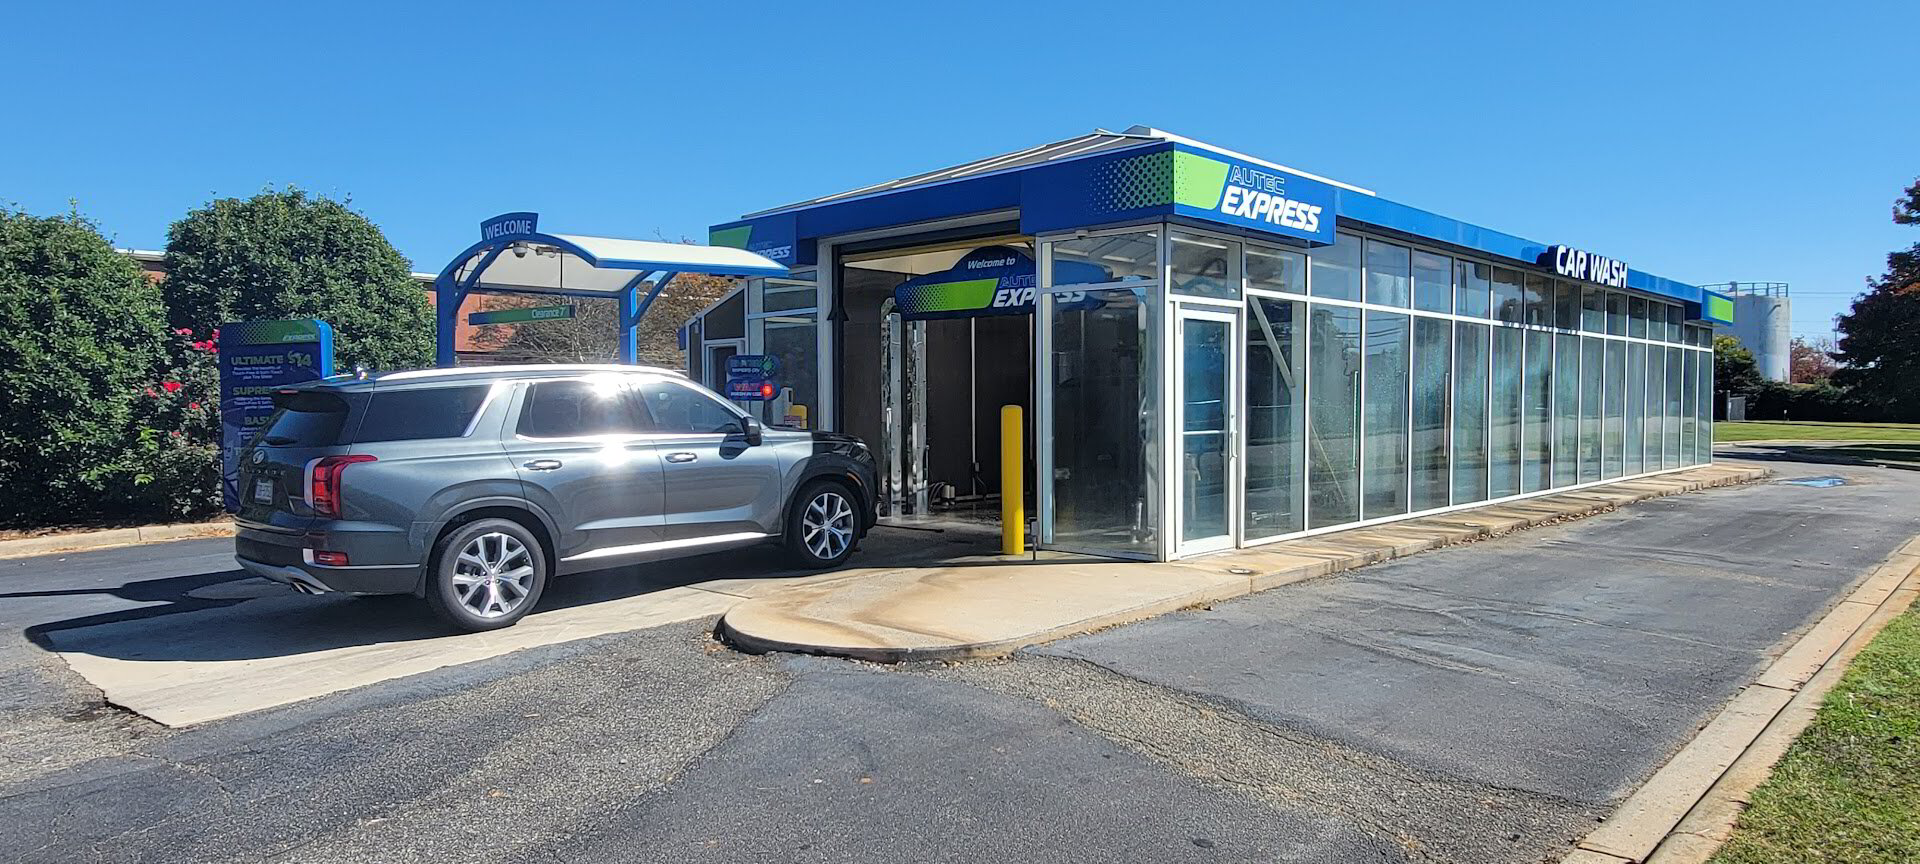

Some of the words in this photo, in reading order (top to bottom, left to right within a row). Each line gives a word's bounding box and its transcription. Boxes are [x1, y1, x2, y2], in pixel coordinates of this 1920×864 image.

[1229, 165, 1285, 195] AUTEC
[485, 220, 532, 240] WELCOME
[967, 258, 1005, 269] Welcome
[1005, 257, 1016, 266] to
[1556, 245, 1587, 280] CAR
[1590, 253, 1628, 289] WASH
[999, 274, 1036, 288] AUTE
[531, 309, 560, 319] Clearance
[230, 355, 284, 366] ULTIMATE
[232, 386, 270, 396] SUPRE
[244, 416, 269, 425] BAS
